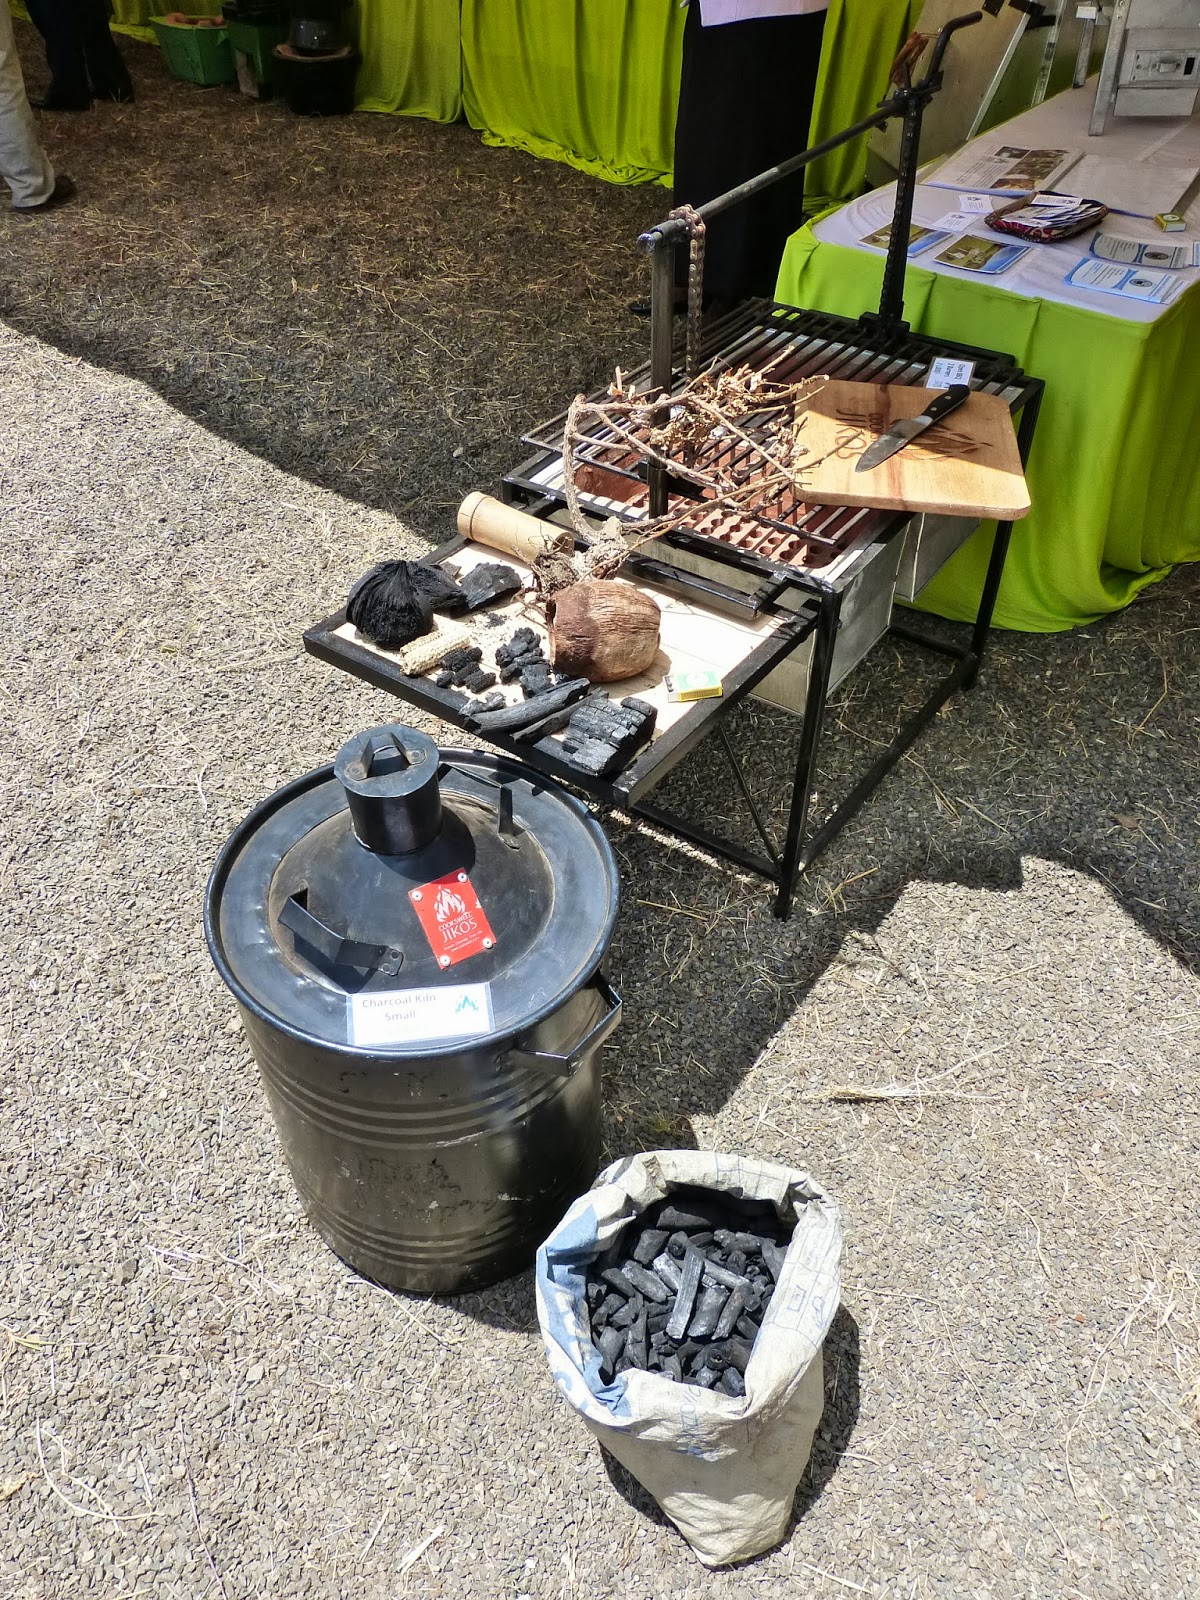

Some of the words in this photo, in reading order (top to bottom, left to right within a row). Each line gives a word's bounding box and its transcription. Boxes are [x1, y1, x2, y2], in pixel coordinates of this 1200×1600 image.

[441, 917, 477, 943] JIKOS
[362, 994, 412, 1008] Charcoal
[415, 993, 437, 1003] Kiln
[385, 1010, 416, 1021] Small
